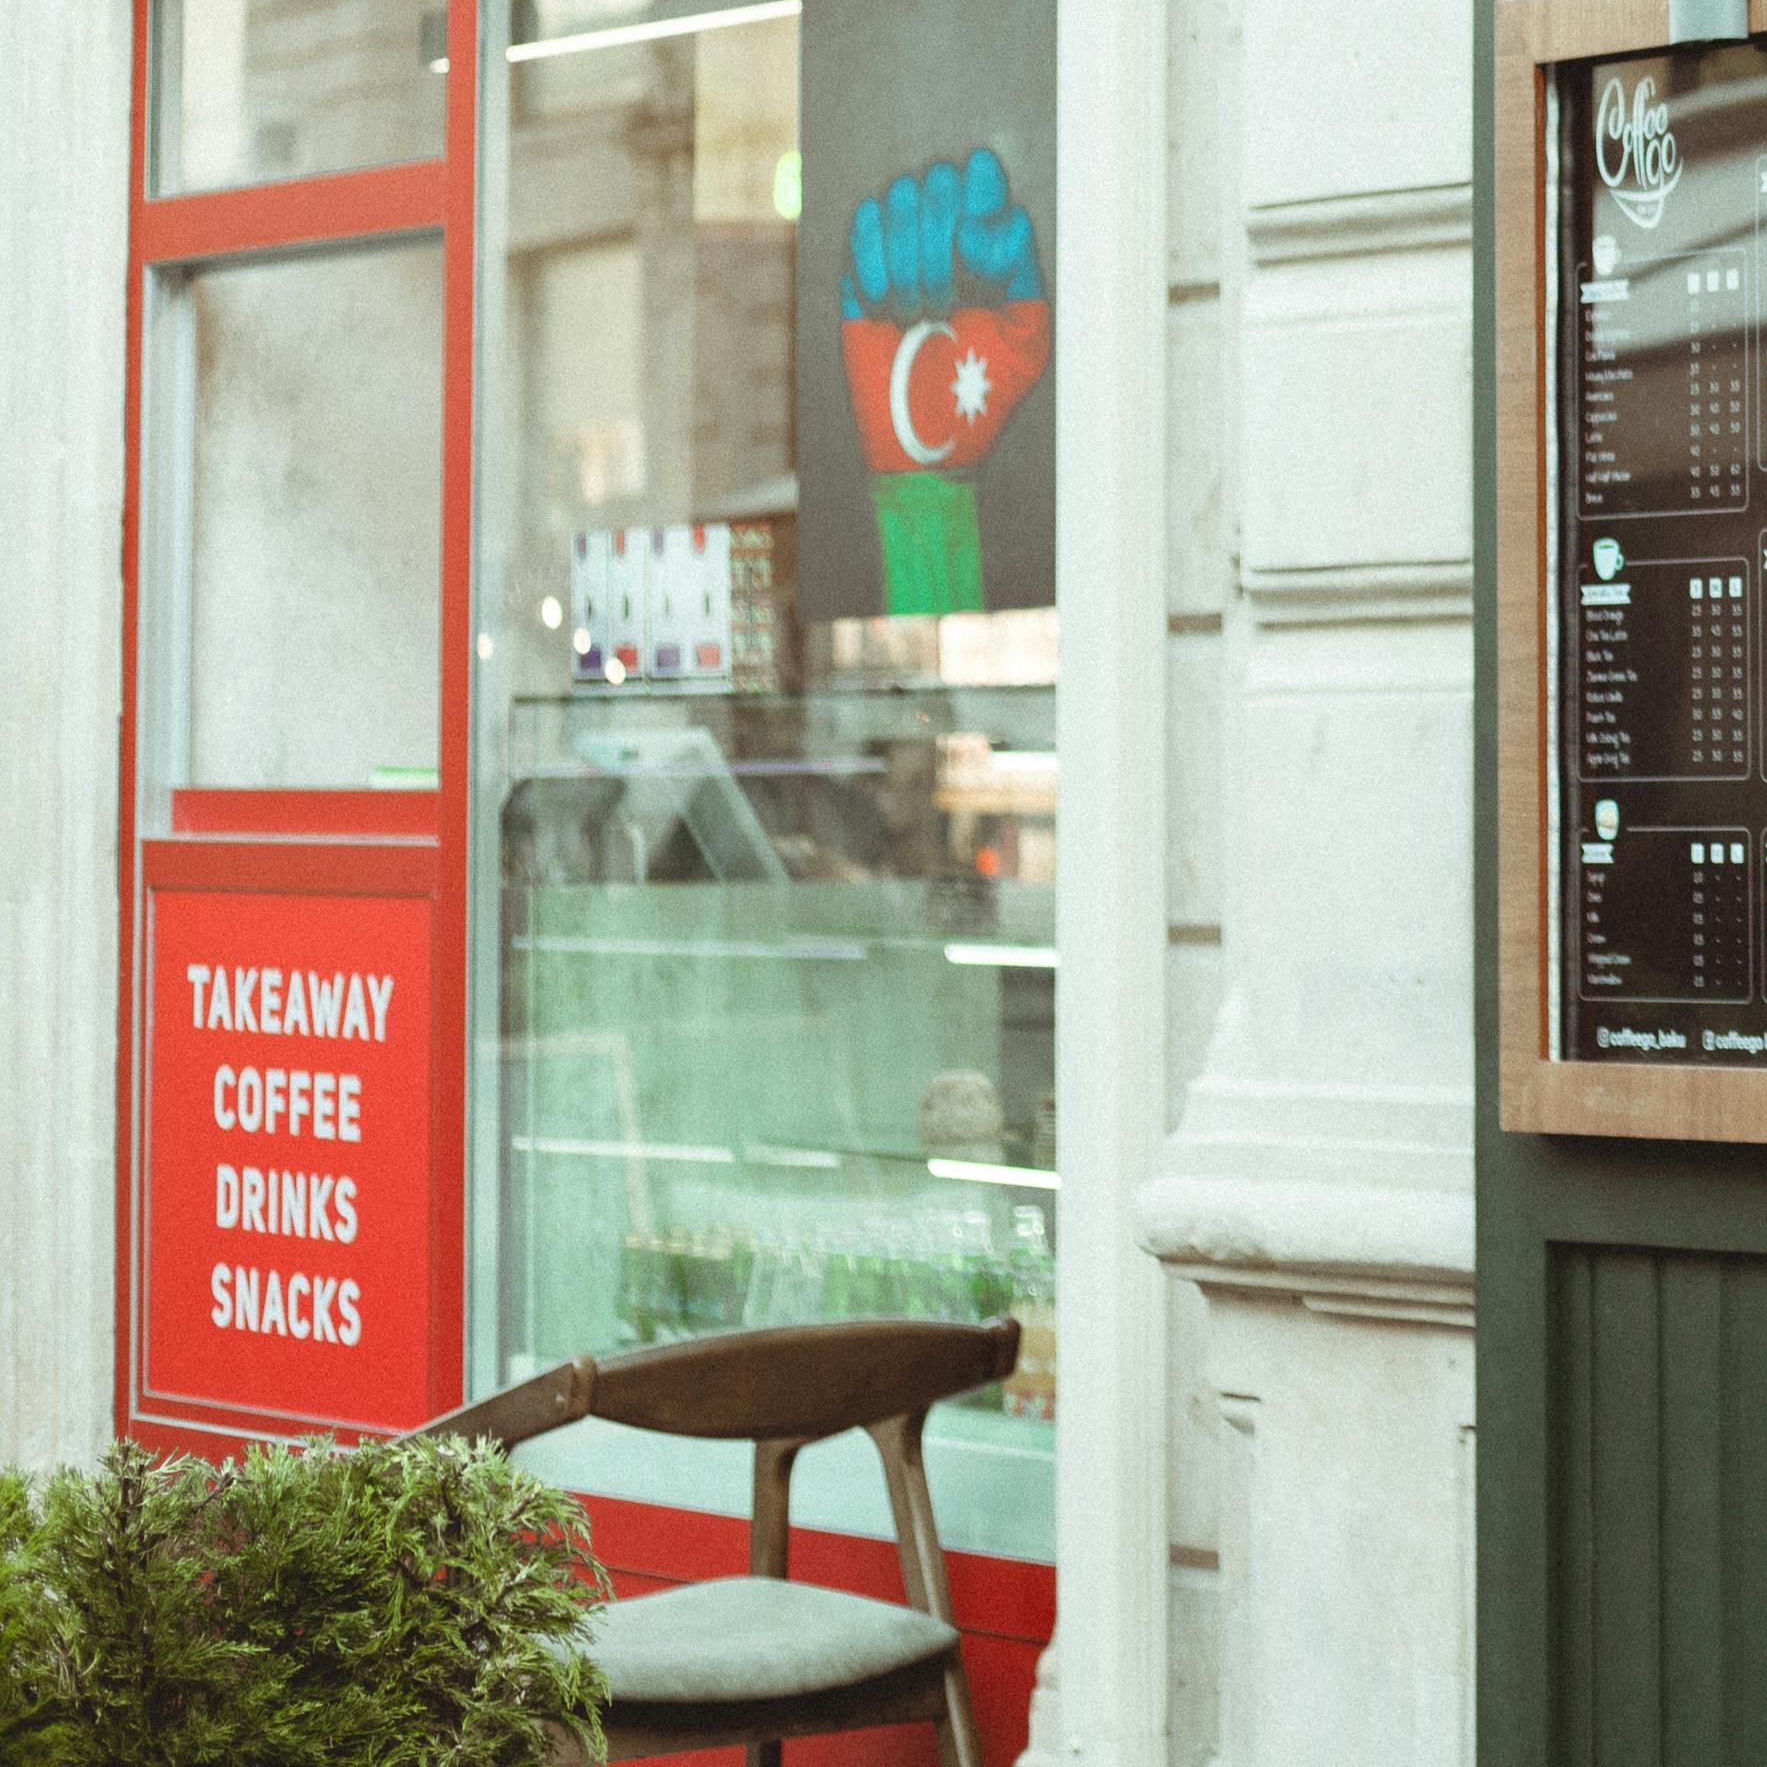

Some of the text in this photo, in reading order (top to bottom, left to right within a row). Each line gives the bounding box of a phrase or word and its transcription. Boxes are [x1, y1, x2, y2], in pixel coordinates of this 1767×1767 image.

[187, 963, 394, 1042] TAKEAWAY
[213, 1064, 361, 1143] COFFEE
[215, 1163, 358, 1244] DRINKS
[210, 1262, 361, 1347] SNACKS
